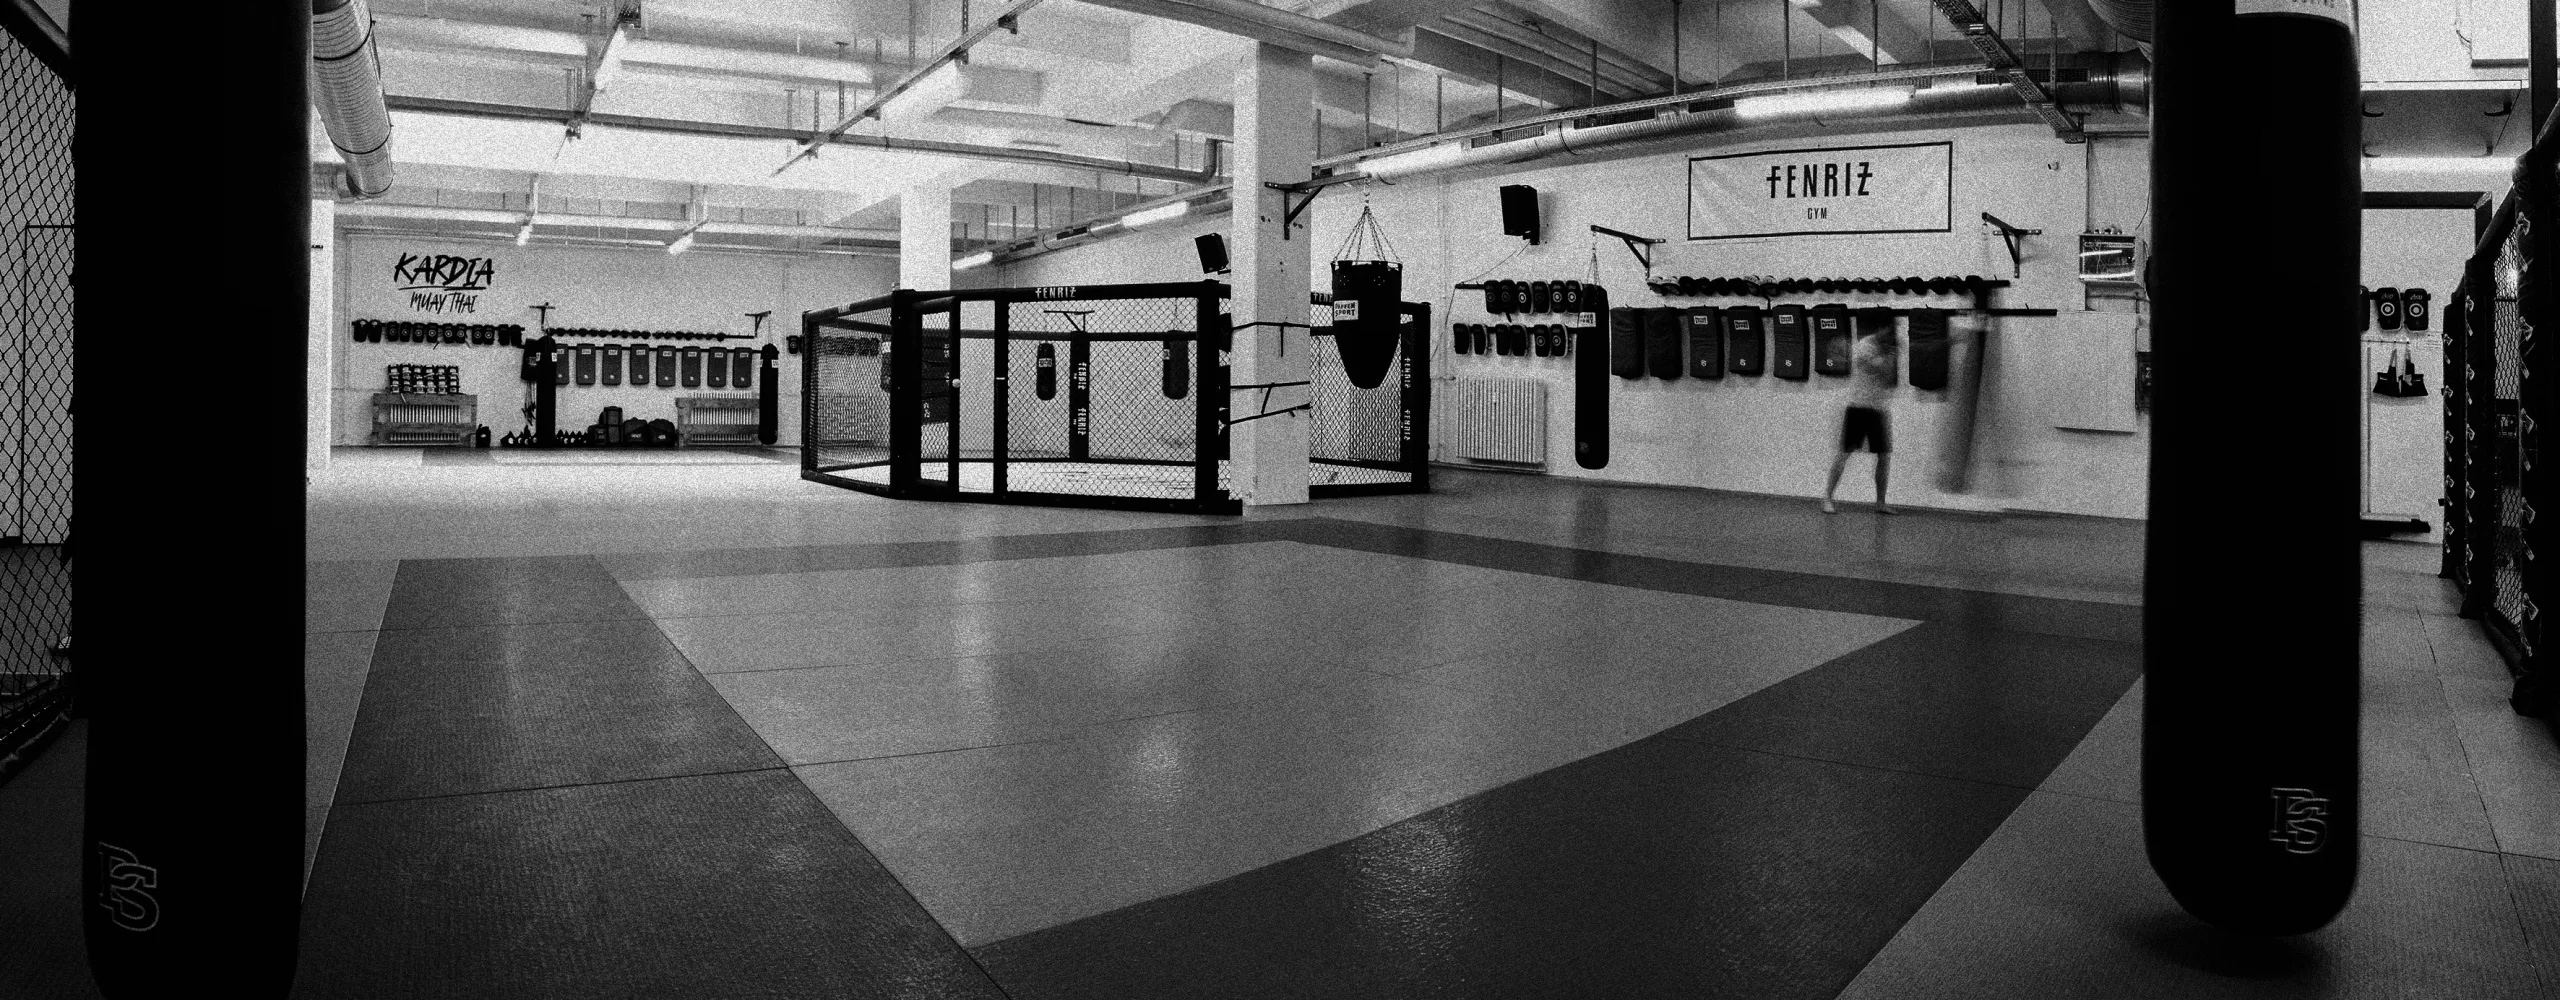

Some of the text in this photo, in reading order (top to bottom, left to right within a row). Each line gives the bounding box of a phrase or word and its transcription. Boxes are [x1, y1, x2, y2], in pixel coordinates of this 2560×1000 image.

[1766, 162, 1873, 199] FENRIZ
[1807, 207, 1828, 220] GYM
[394, 252, 495, 288] KARDIA
[410, 291, 478, 314] MUAY THAI
[1035, 286, 1077, 299] FENRIZ
